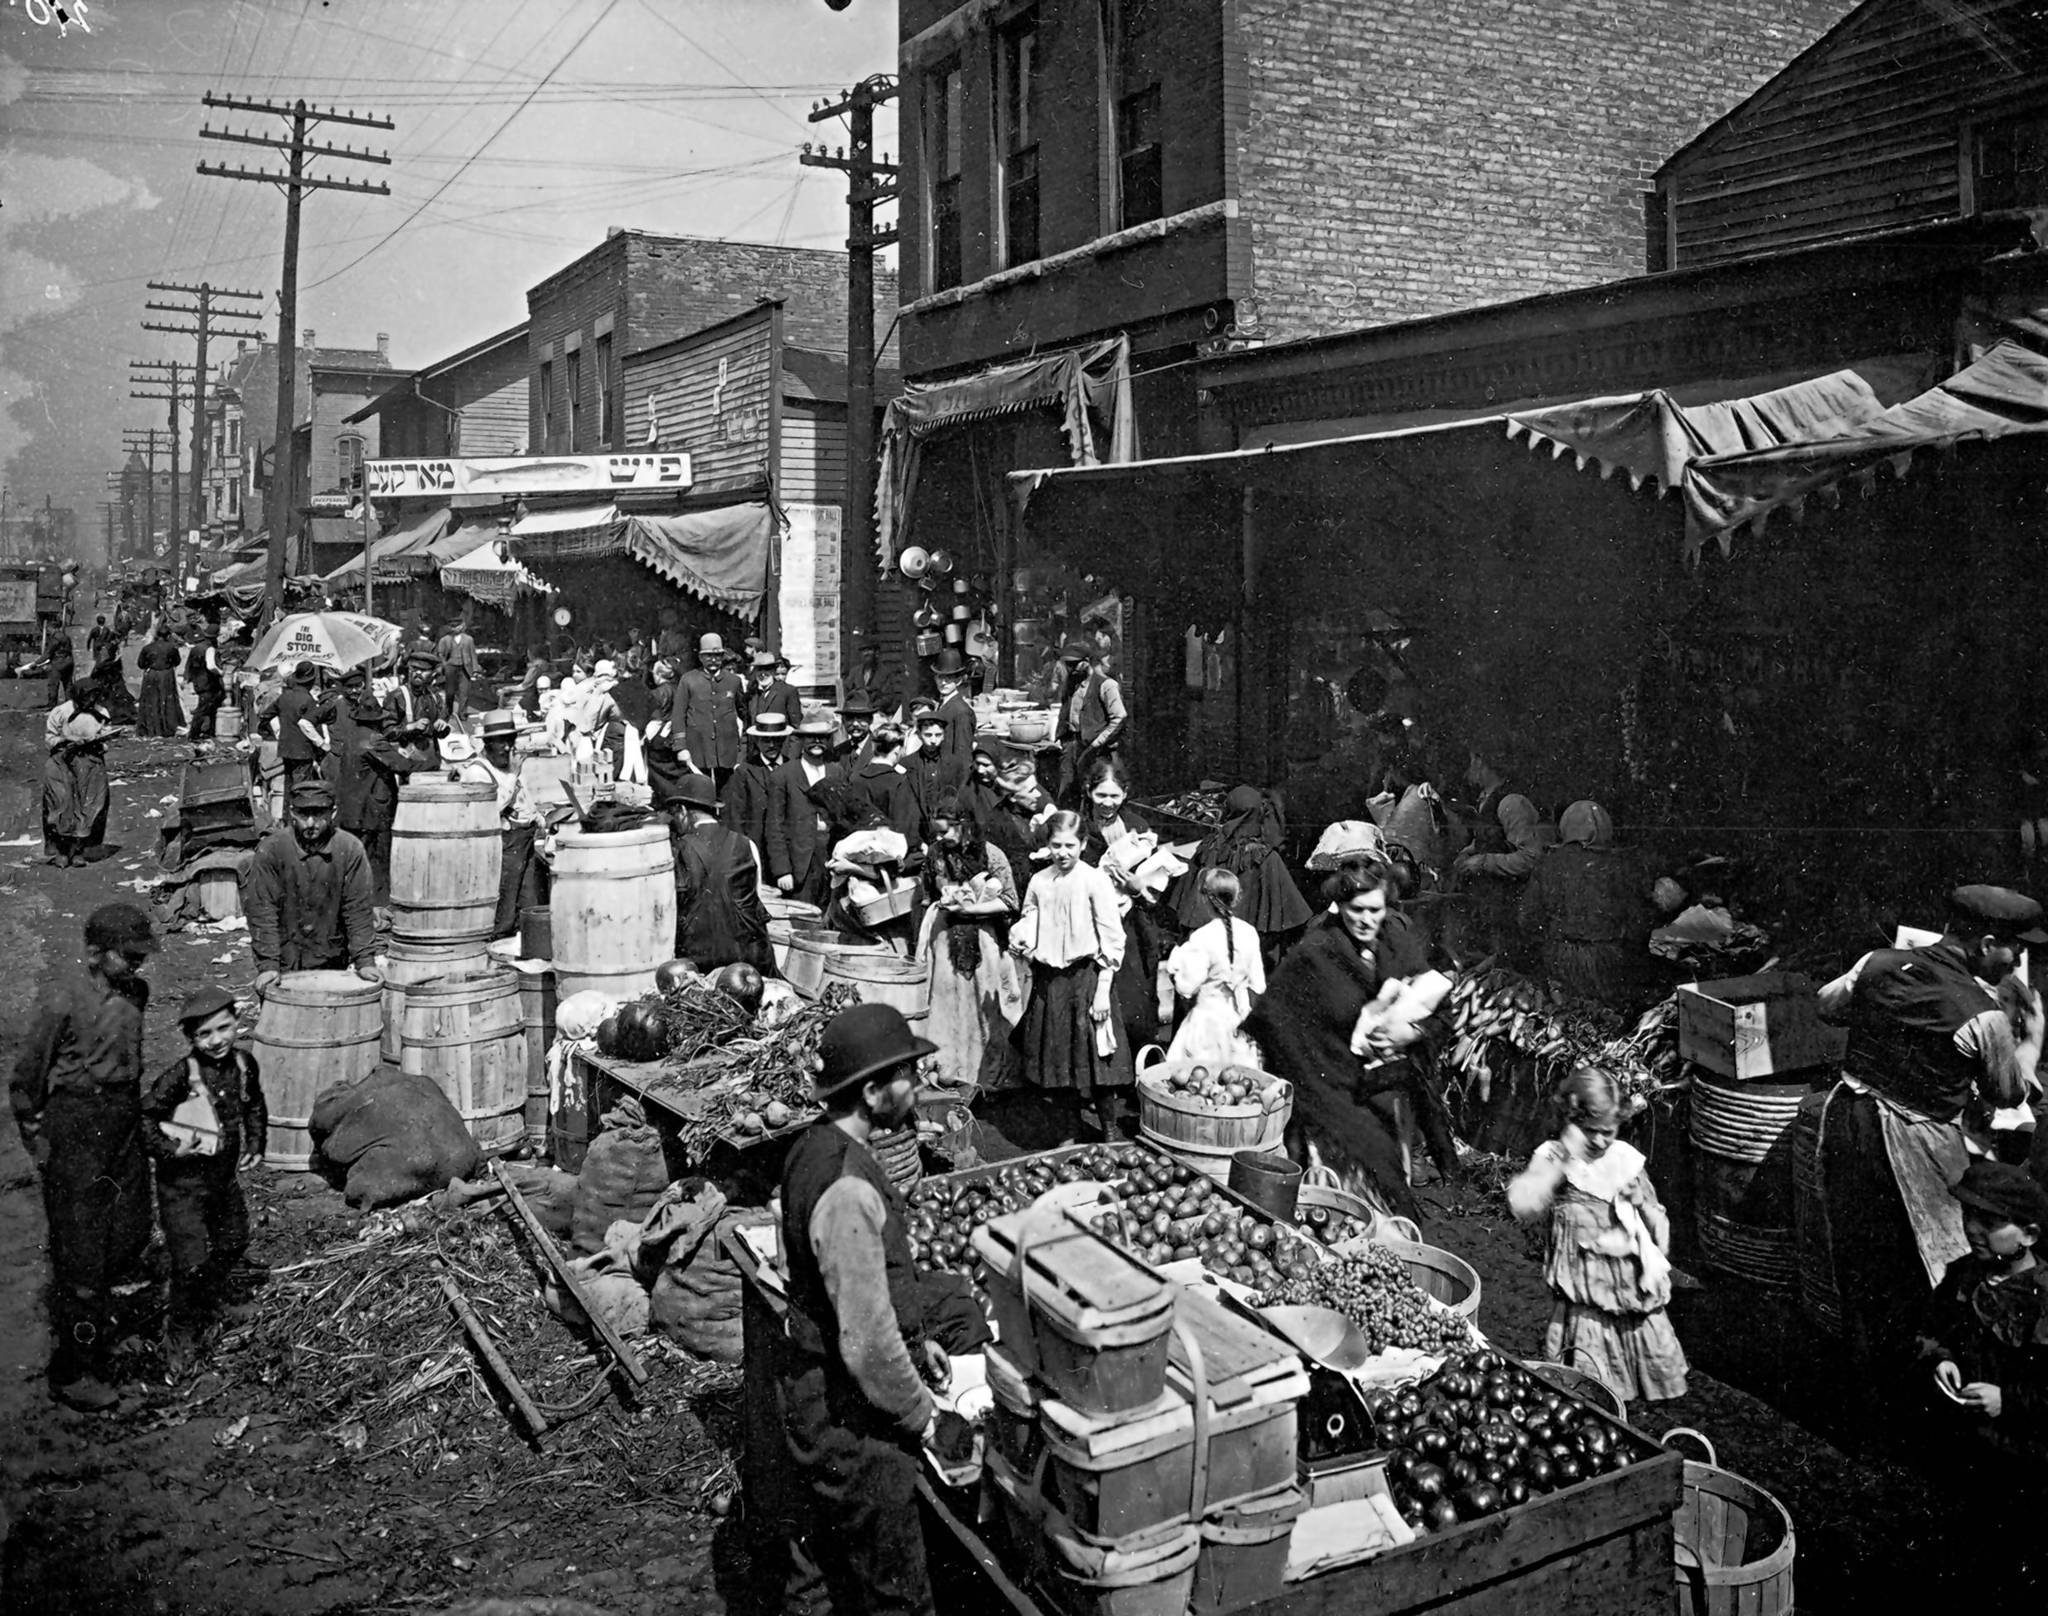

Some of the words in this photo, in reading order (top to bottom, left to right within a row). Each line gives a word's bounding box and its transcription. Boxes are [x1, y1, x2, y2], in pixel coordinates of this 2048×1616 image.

[609, 457, 682, 483] פיש
[295, 632, 313, 642] BIG
[286, 642, 322, 653] STORE
